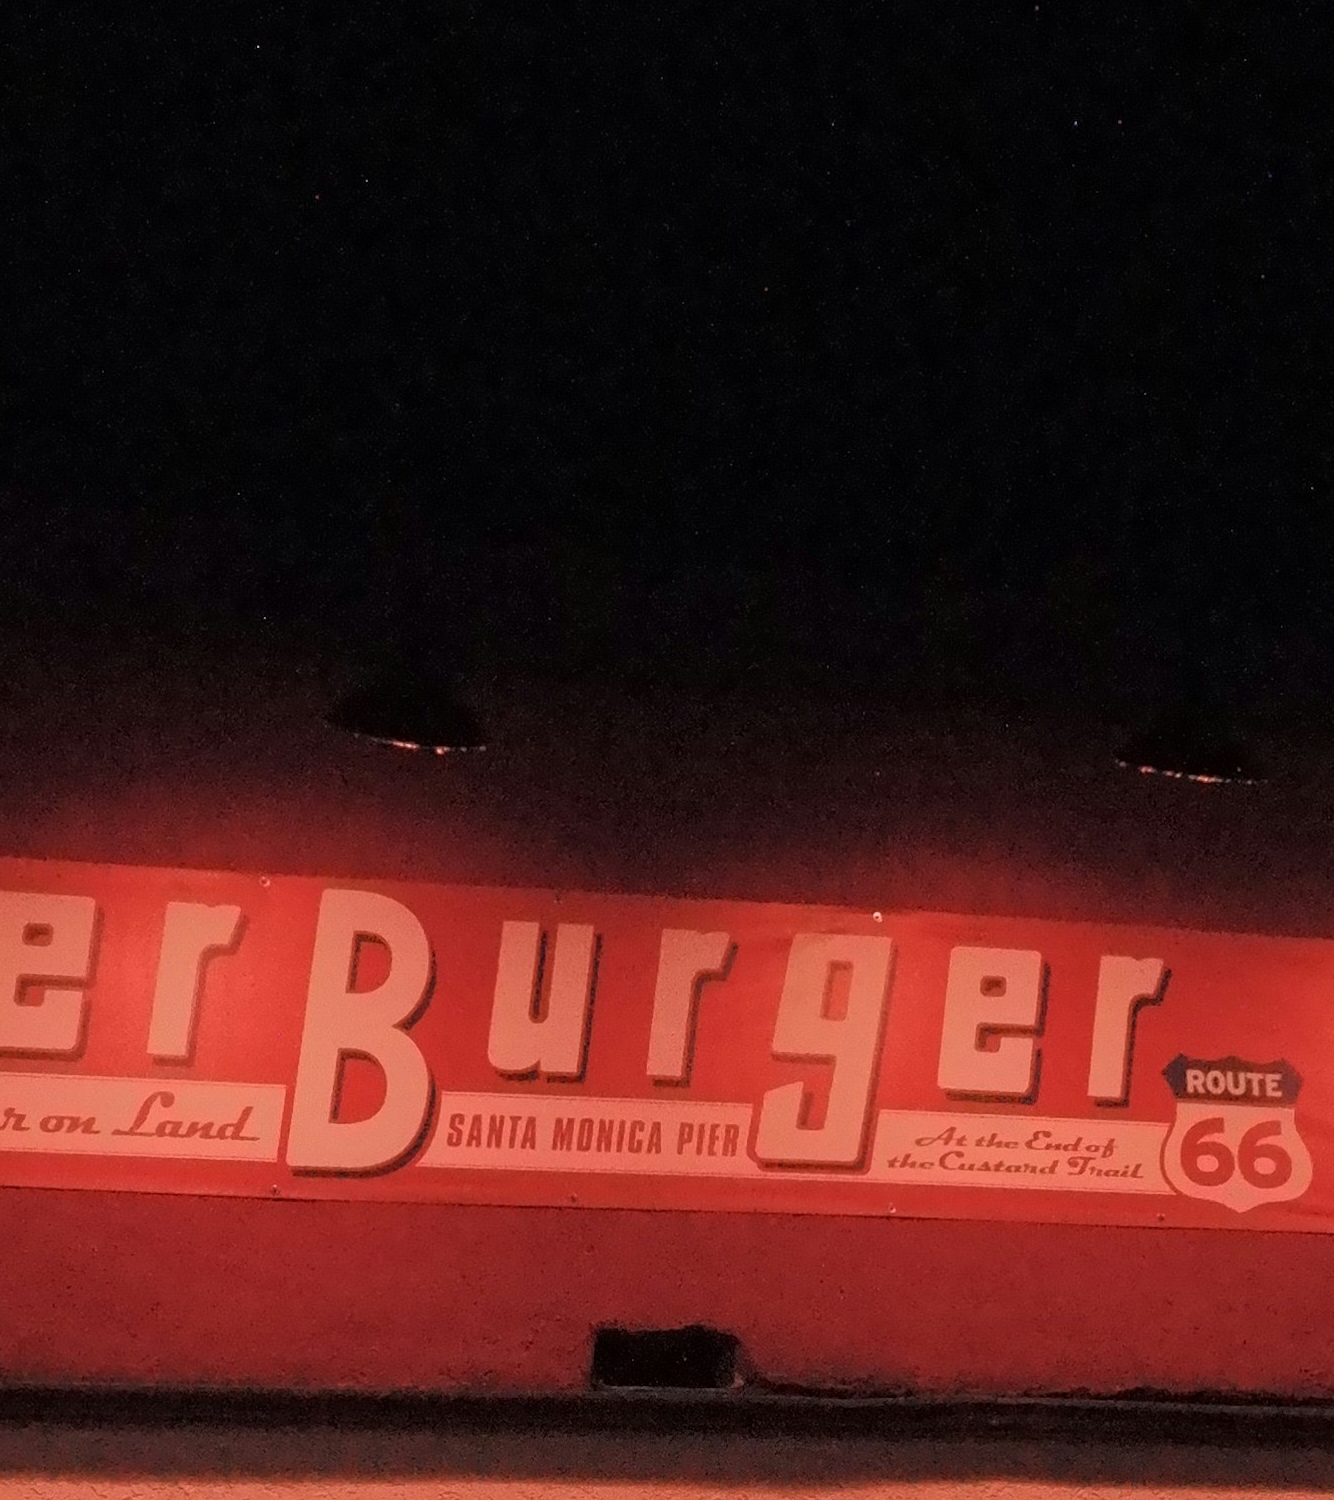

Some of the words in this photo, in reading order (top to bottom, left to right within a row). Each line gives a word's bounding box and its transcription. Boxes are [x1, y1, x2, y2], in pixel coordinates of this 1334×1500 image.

[1186, 1069, 1283, 1097] ROUTE
[39, 1115, 100, 1134] on
[112, 1091, 259, 1141] Land
[446, 1112, 537, 1150] SANTA
[551, 1117, 662, 1154] MONICA
[677, 1121, 740, 1157] PIER
[915, 1126, 968, 1147] At
[975, 1133, 1019, 1149] the
[1025, 1130, 1083, 1151] End
[1085, 1138, 1117, 1158] of
[1180, 1117, 1293, 1189] 66
[887, 1153, 935, 1170] the
[939, 1151, 1059, 1175] Custard
[1067, 1156, 1144, 1178] Trail
